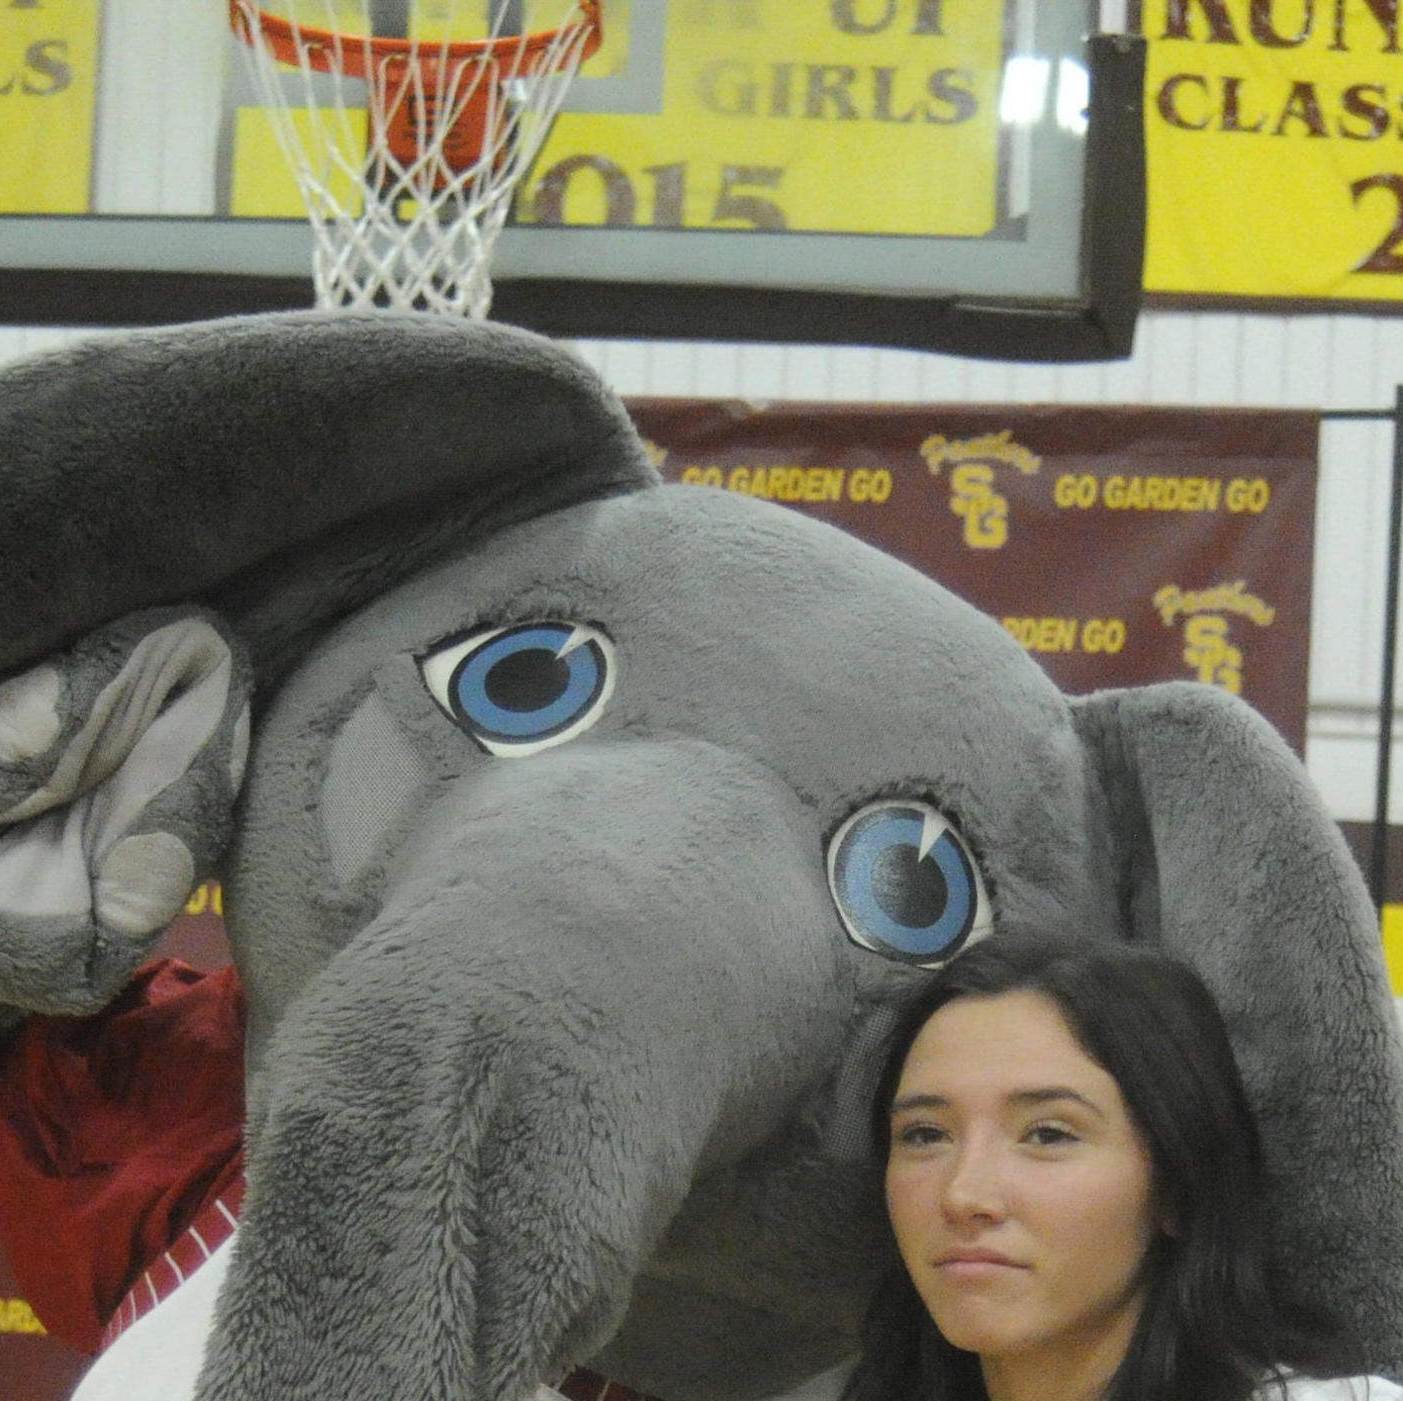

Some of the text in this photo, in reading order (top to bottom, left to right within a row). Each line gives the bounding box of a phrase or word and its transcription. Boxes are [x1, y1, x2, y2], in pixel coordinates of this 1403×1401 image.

[695, 57, 980, 125] GIRLS
[526, 153, 789, 229] 015
[847, 468, 894, 504] GO
[1055, 474, 1272, 514] GO GARDEN GO
[1001, 616, 1129, 655] RDEN GO
